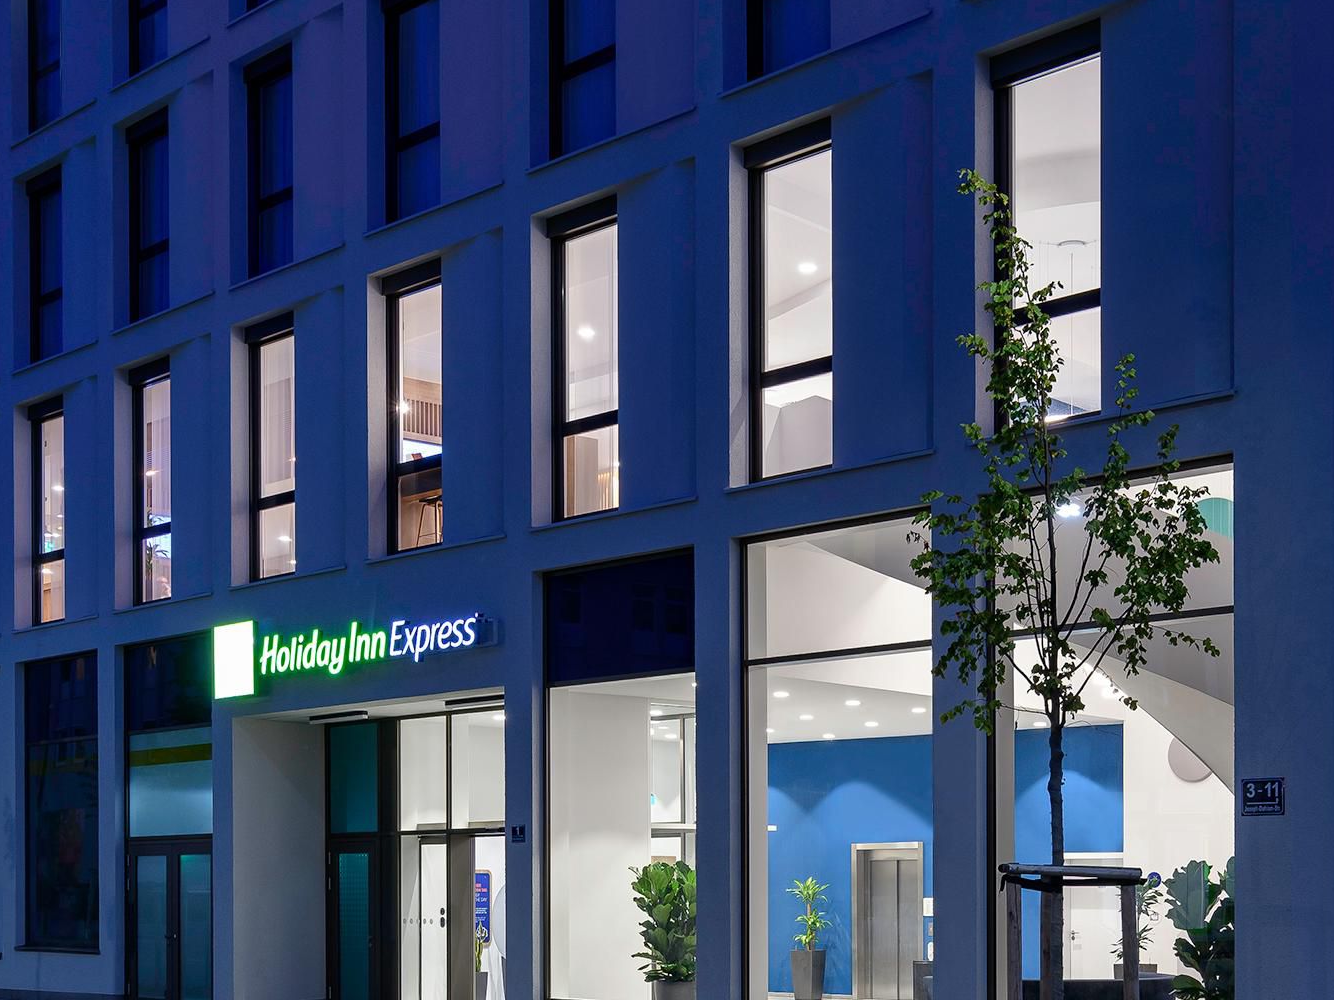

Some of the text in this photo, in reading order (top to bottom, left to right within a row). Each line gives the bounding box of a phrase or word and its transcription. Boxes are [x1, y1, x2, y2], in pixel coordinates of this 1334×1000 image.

[260, 615, 476, 675] Holiday Inn Express
